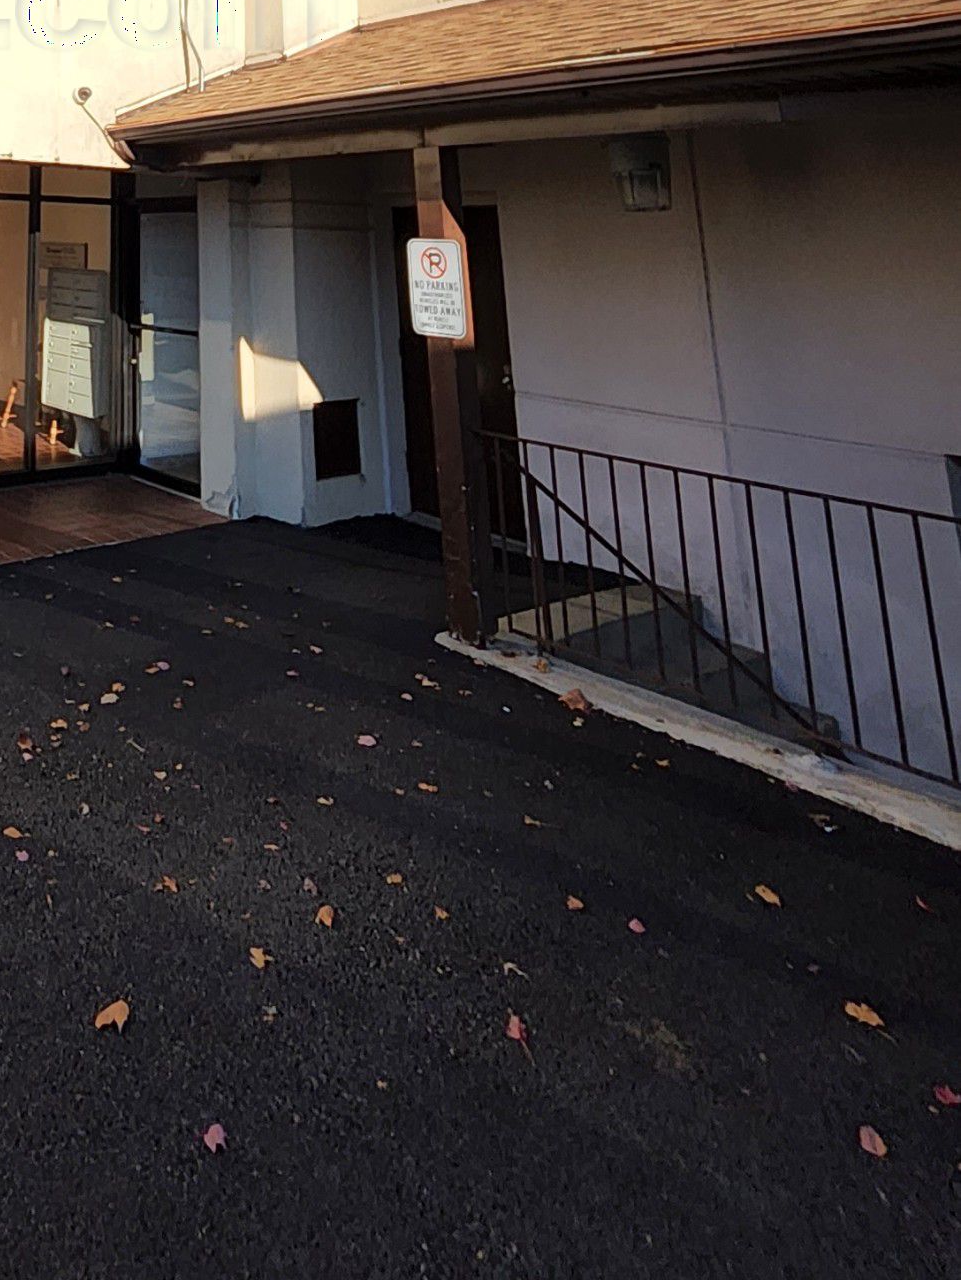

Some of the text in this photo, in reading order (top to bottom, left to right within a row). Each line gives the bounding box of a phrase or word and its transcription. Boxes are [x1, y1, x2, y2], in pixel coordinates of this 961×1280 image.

[414, 280, 459, 292] NO PARKING
[414, 304, 461, 317] TOWED AWAY
